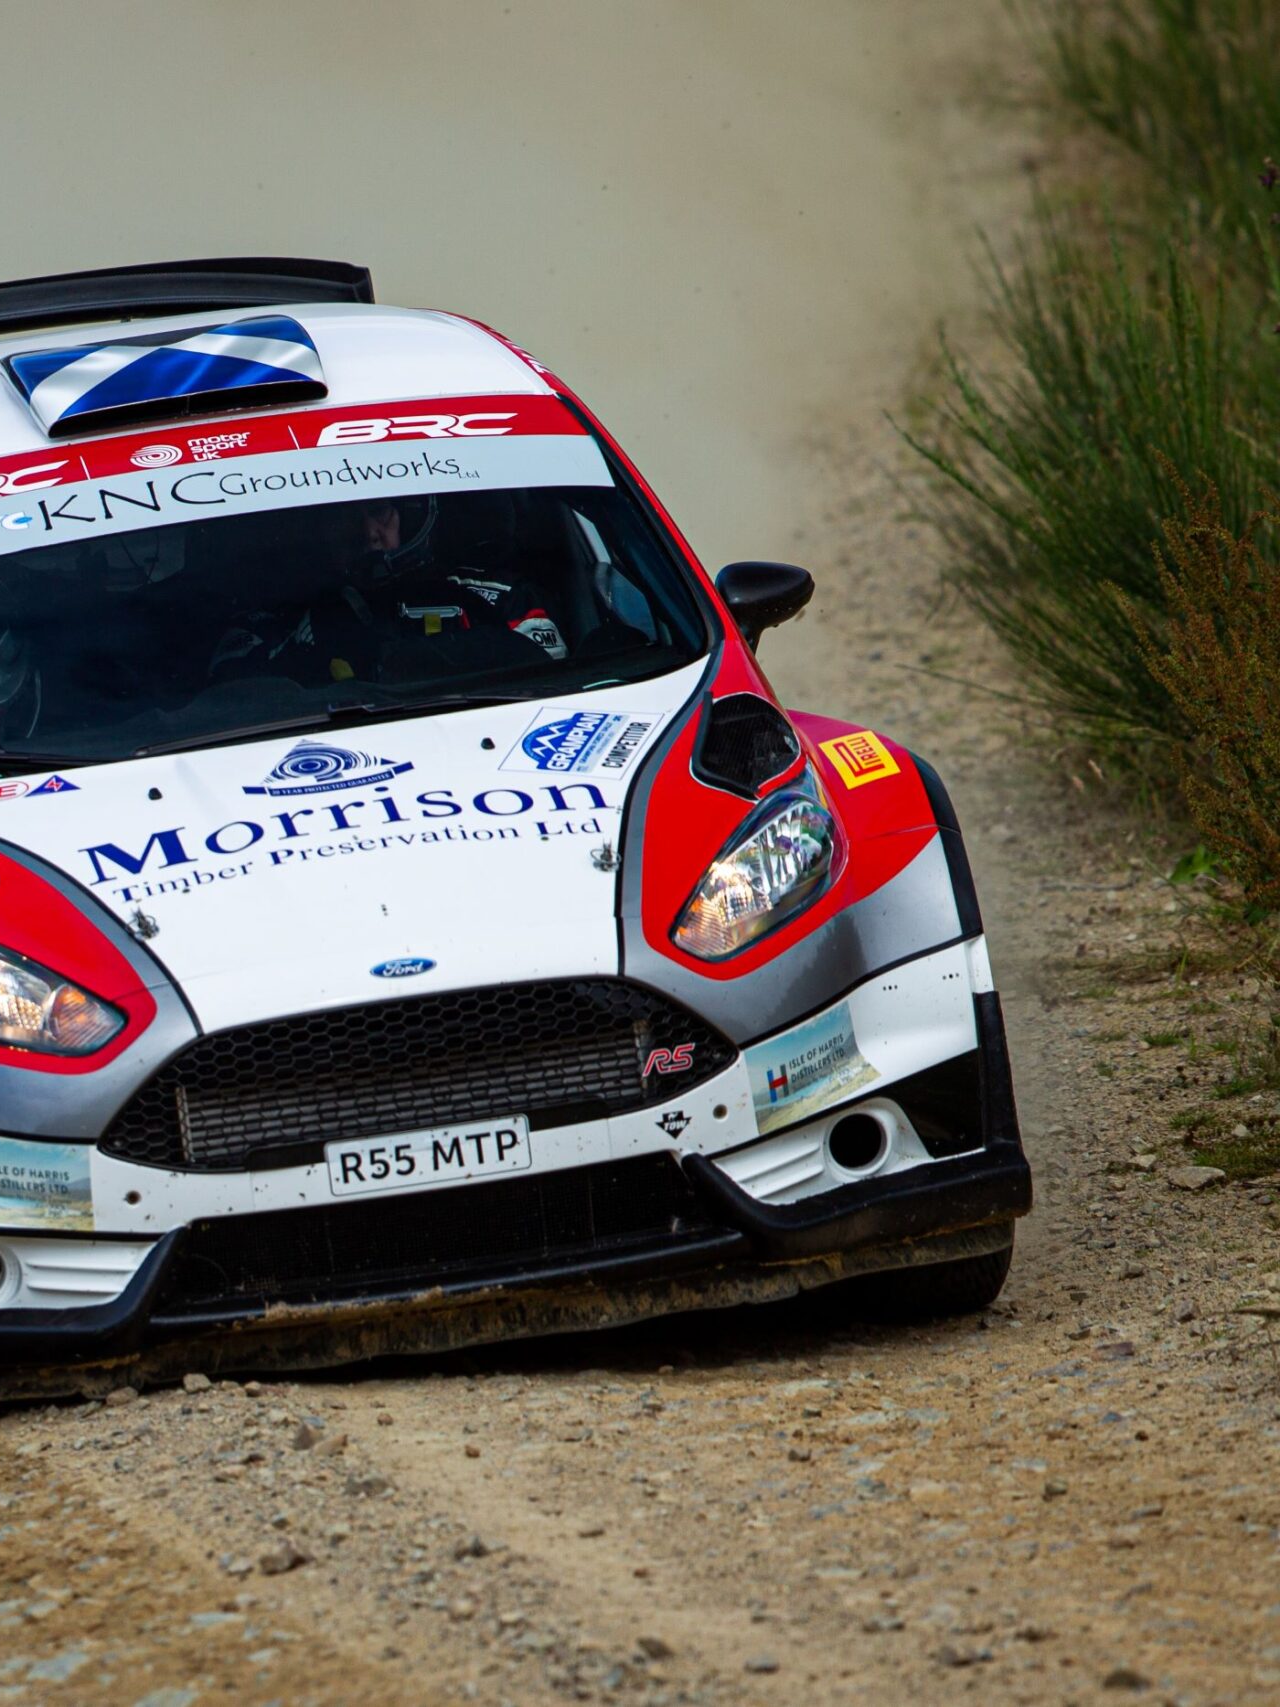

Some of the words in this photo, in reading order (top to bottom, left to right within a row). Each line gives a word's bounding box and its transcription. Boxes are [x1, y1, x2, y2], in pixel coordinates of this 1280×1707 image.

[187, 432, 251, 447] motor
[191, 439, 247, 454] sport
[316, 413, 519, 446] BRC
[37, 471, 226, 531] KNC
[219, 452, 460, 496] Groundworks
[546, 713, 605, 771] GRAMPIAN
[601, 721, 652, 769] COMPETITOR
[832, 736, 886, 778] PIRELLI
[77, 783, 616, 886] Morrison
[112, 859, 255, 904] Timber
[268, 819, 521, 867] Preservation
[534, 816, 603, 841] Ltd
[382, 960, 424, 977] Ford
[642, 1043, 696, 1077] RS
[788, 1053, 806, 1071] ISLE
[806, 1048, 818, 1061] OF
[818, 1033, 845, 1054] HARRIS
[664, 1119, 687, 1131] TOW
[11, 1166, 26, 1177] OF
[28, 1169, 70, 1182] HARRIS
[339, 1143, 417, 1184] R55
[431, 1128, 520, 1172] MTP
